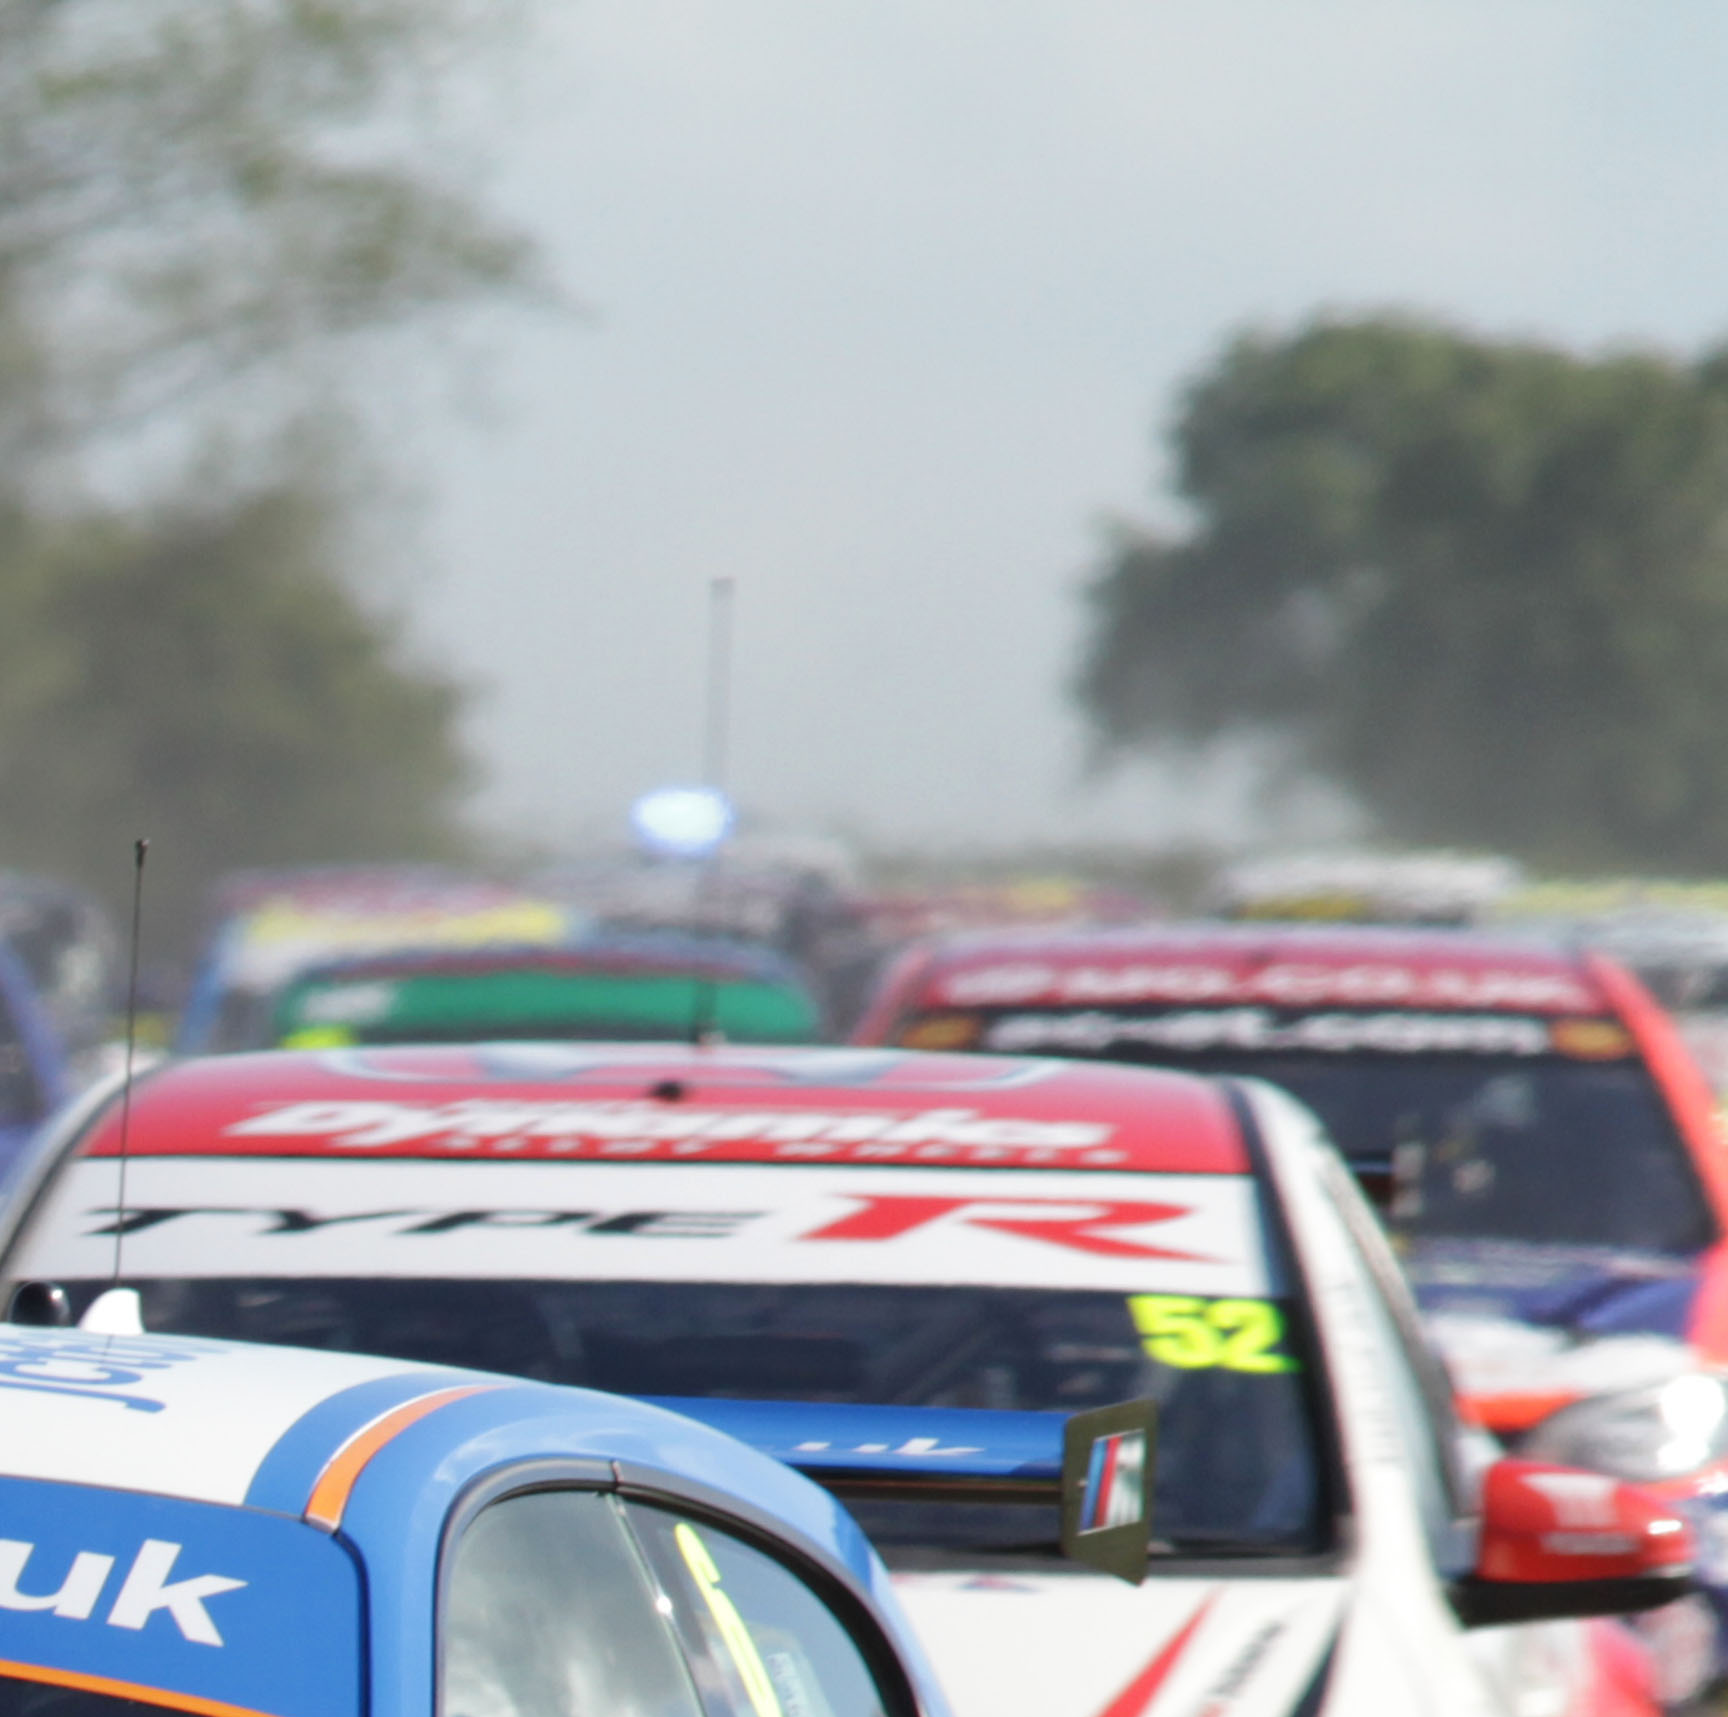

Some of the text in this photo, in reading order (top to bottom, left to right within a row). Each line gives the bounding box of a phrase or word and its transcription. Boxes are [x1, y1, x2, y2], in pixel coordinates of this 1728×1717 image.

[80, 1195, 1234, 1262] TYPE R
[1126, 1295, 1300, 1373] 52
